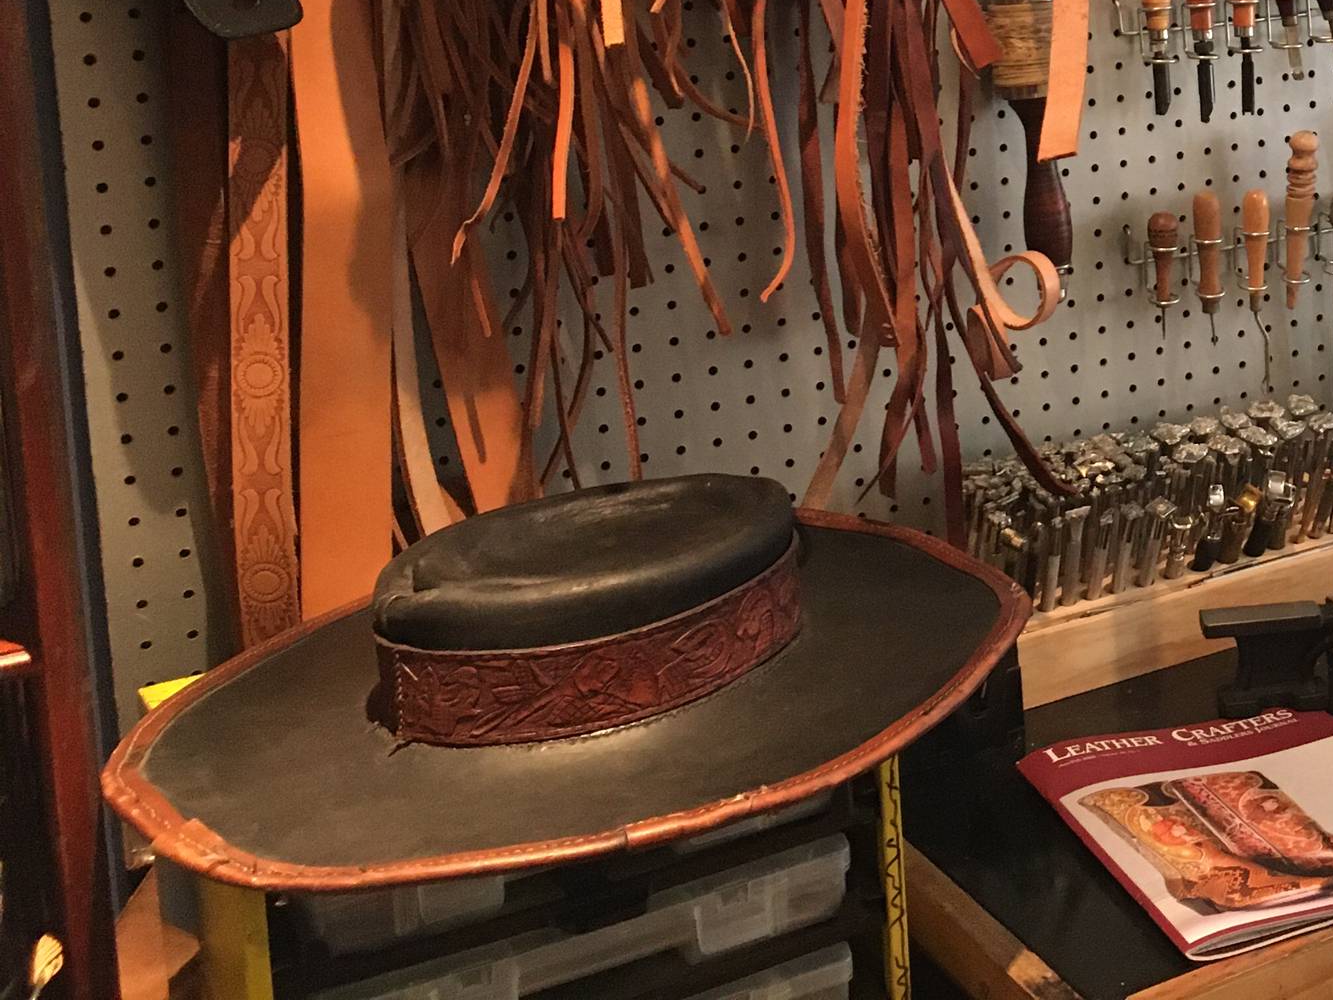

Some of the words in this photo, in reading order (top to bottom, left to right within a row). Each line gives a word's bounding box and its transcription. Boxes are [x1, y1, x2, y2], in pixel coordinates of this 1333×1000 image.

[1043, 735, 1164, 763] LEATHER
[1171, 709, 1294, 742] CRAFTERS
[1199, 730, 1254, 745] SADDLERS
